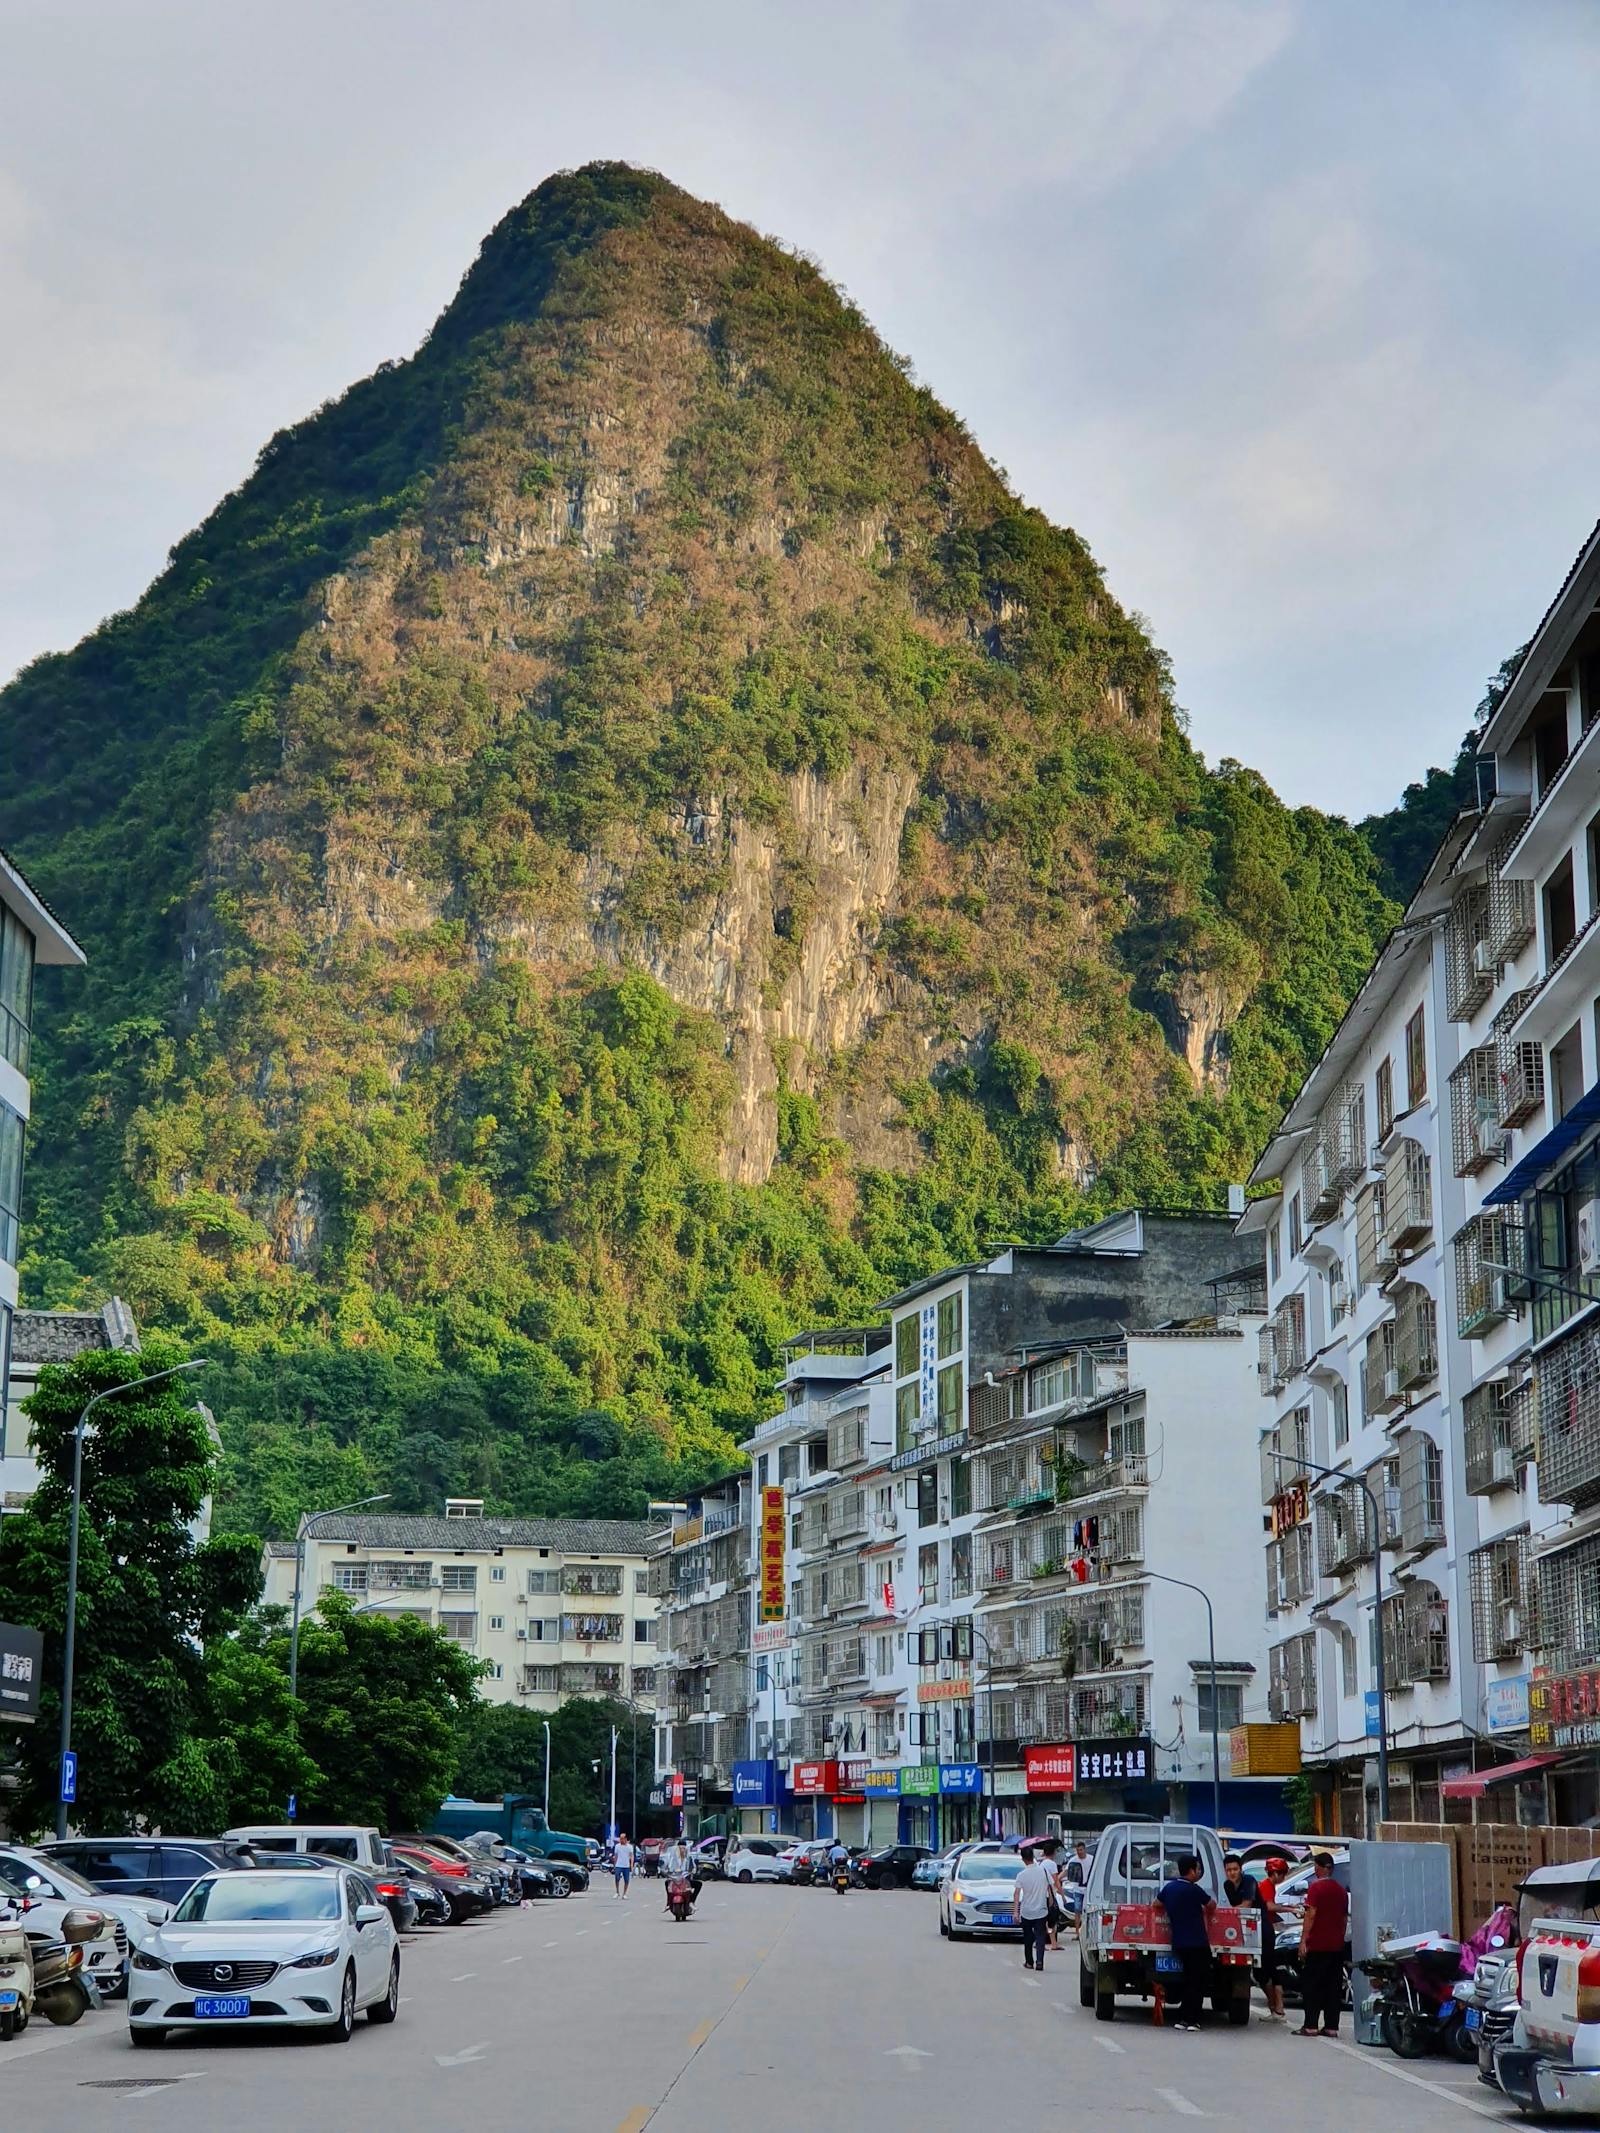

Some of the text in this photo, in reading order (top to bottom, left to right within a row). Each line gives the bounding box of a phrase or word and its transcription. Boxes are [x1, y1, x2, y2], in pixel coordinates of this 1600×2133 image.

[1081, 1752, 1123, 1778] 宝宝巴士
[1471, 1853, 1532, 1865] Casarte
